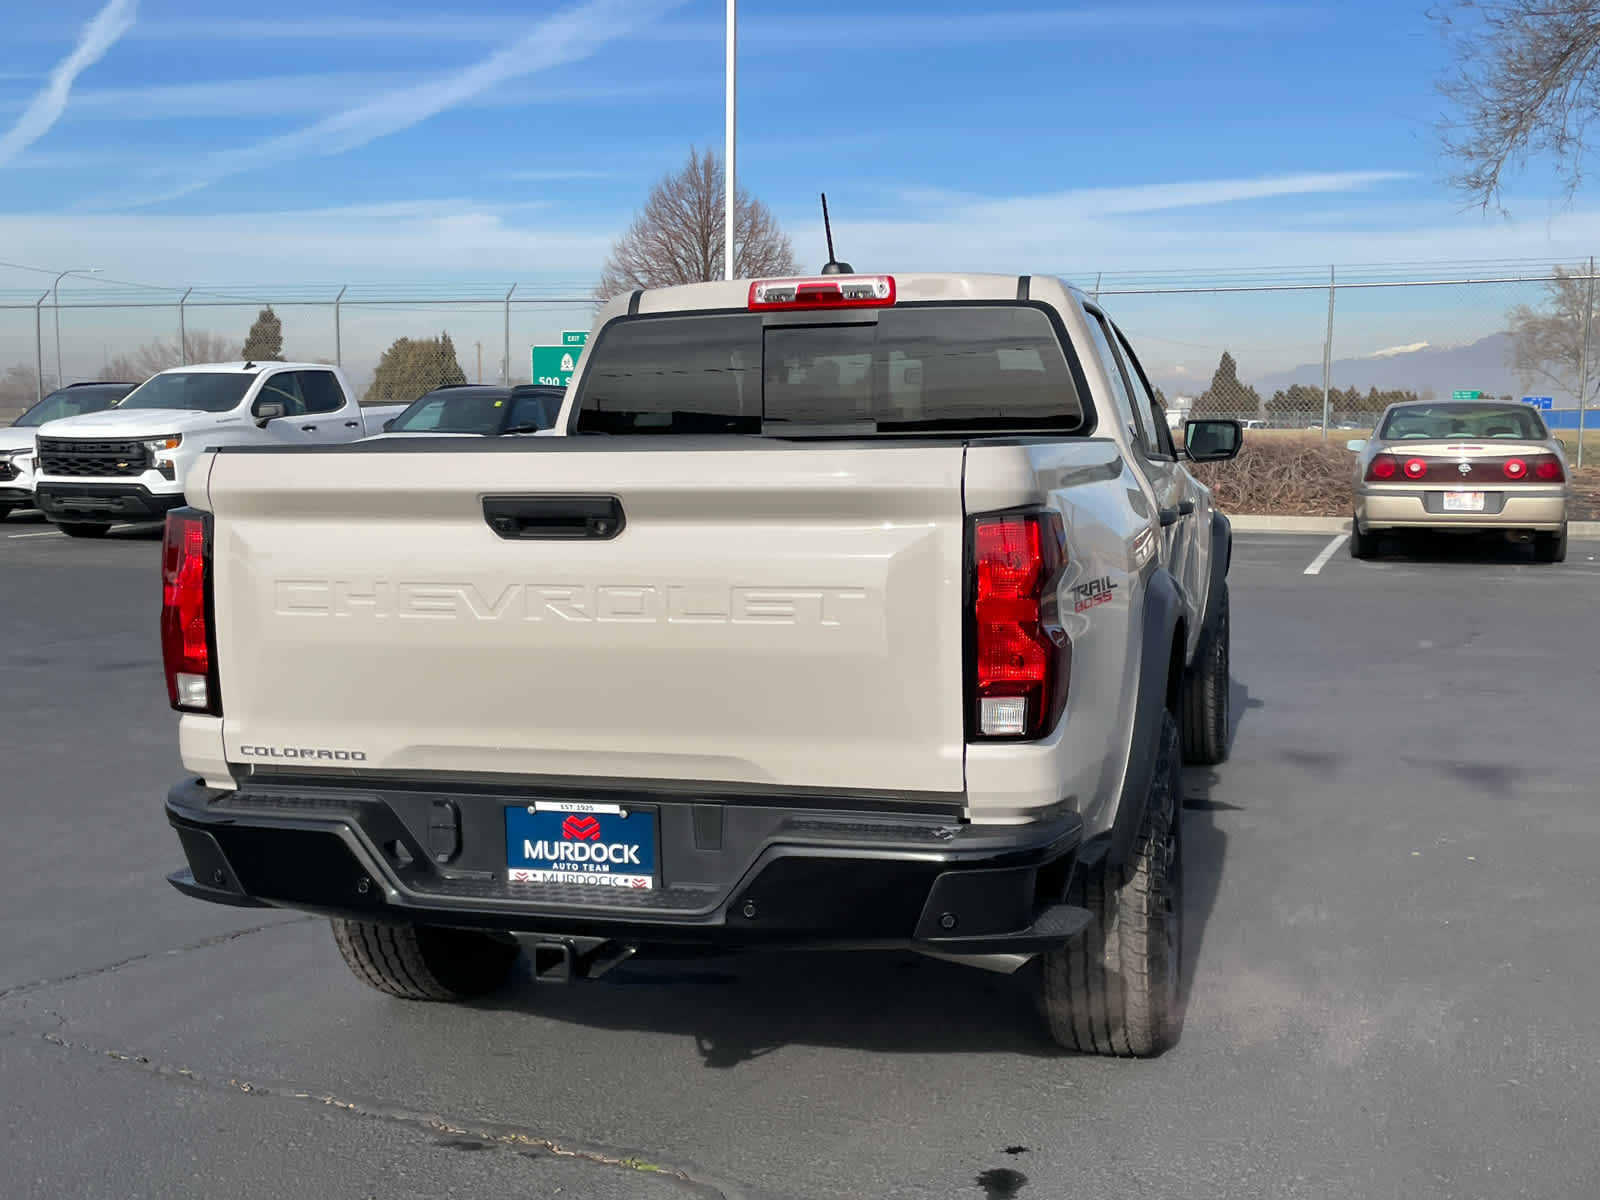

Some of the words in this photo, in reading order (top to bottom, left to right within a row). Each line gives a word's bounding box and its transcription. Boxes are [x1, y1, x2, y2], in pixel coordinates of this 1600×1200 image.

[1072, 576, 1118, 601] TRAIL
[274, 579, 866, 624] CHEVROLET
[1075, 590, 1113, 613] BOSS
[240, 745, 367, 761] COLORADO
[576, 804, 594, 812] 1925
[524, 840, 640, 864] MURDOCK
[552, 862, 579, 871] AUTO
[583, 864, 610, 873] TEAM
[542, 873, 618, 887] MURDOCK
